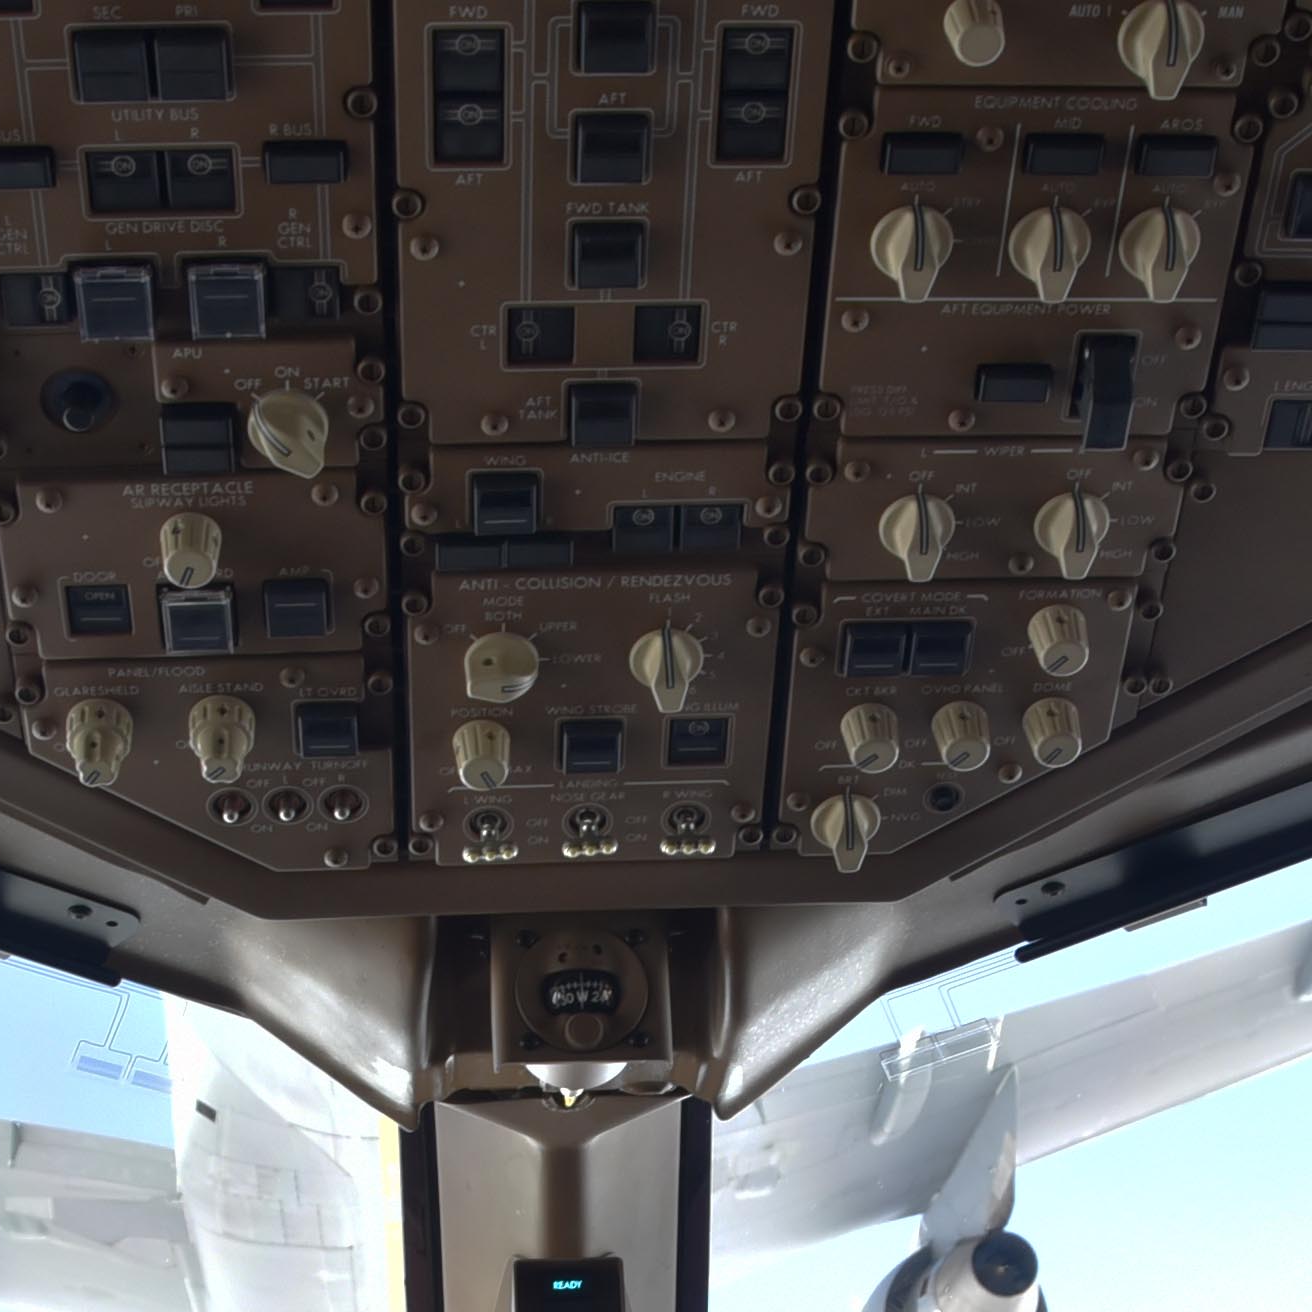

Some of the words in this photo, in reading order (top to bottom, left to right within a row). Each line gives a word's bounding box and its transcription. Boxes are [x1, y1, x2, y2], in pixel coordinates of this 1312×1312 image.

[94, 6, 121, 20] SEC
[176, 4, 198, 16] PRI
[449, 5, 487, 19] FWD
[742, 4, 779, 18] FWD
[1069, 5, 1100, 19] AUTO
[1217, 5, 1245, 20] MAN
[598, 92, 627, 105] AFT
[974, 96, 1060, 111] EQUIPMENT
[1066, 96, 1138, 112] COOLING
[112, 108, 163, 122] UTILITY
[169, 107, 200, 120] BUS
[909, 116, 942, 129] FWD
[1055, 117, 1082, 130] MID
[281, 123, 312, 137] BUS
[454, 173, 484, 187] AFT
[736, 171, 764, 184] AFT
[566, 203, 602, 216] FWD
[609, 203, 650, 215] TANK
[105, 223, 138, 235] GEN
[142, 221, 185, 234] DRIVE
[190, 221, 224, 233] DISC
[277, 222, 311, 236] GEN
[276, 235, 312, 249] CTRL
[941, 304, 967, 316] AFT
[970, 304, 1052, 318] EQUIPMENT
[1055, 304, 1112, 317] POWER
[470, 325, 496, 337] CTR
[711, 321, 737, 333] CTR
[172, 347, 203, 361] APU
[1142, 354, 1167, 366] OFF
[275, 366, 299, 378] ON
[233, 378, 261, 391] OFF
[304, 377, 351, 390] START
[525, 396, 551, 408] AFT
[519, 408, 558, 421] TANK
[485, 455, 527, 466] WING
[908, 469, 936, 482] OFF
[1067, 468, 1094, 480] OFF
[122, 484, 144, 497] AR
[149, 481, 254, 496] RECEPTACLE
[459, 579, 497, 592] ANTI
[514, 576, 601, 589] COLLISION
[621, 574, 732, 587] RENDEZVOUS
[862, 592, 917, 604] COVERT
[920, 591, 961, 603] MODE
[107, 666, 206, 679] PANEL/FLOOD
[53, 685, 139, 697] GLARESHIELD
[545, 705, 583, 716] WING
[588, 704, 638, 714] STROBE
[552, 1280, 584, 1290] READY
